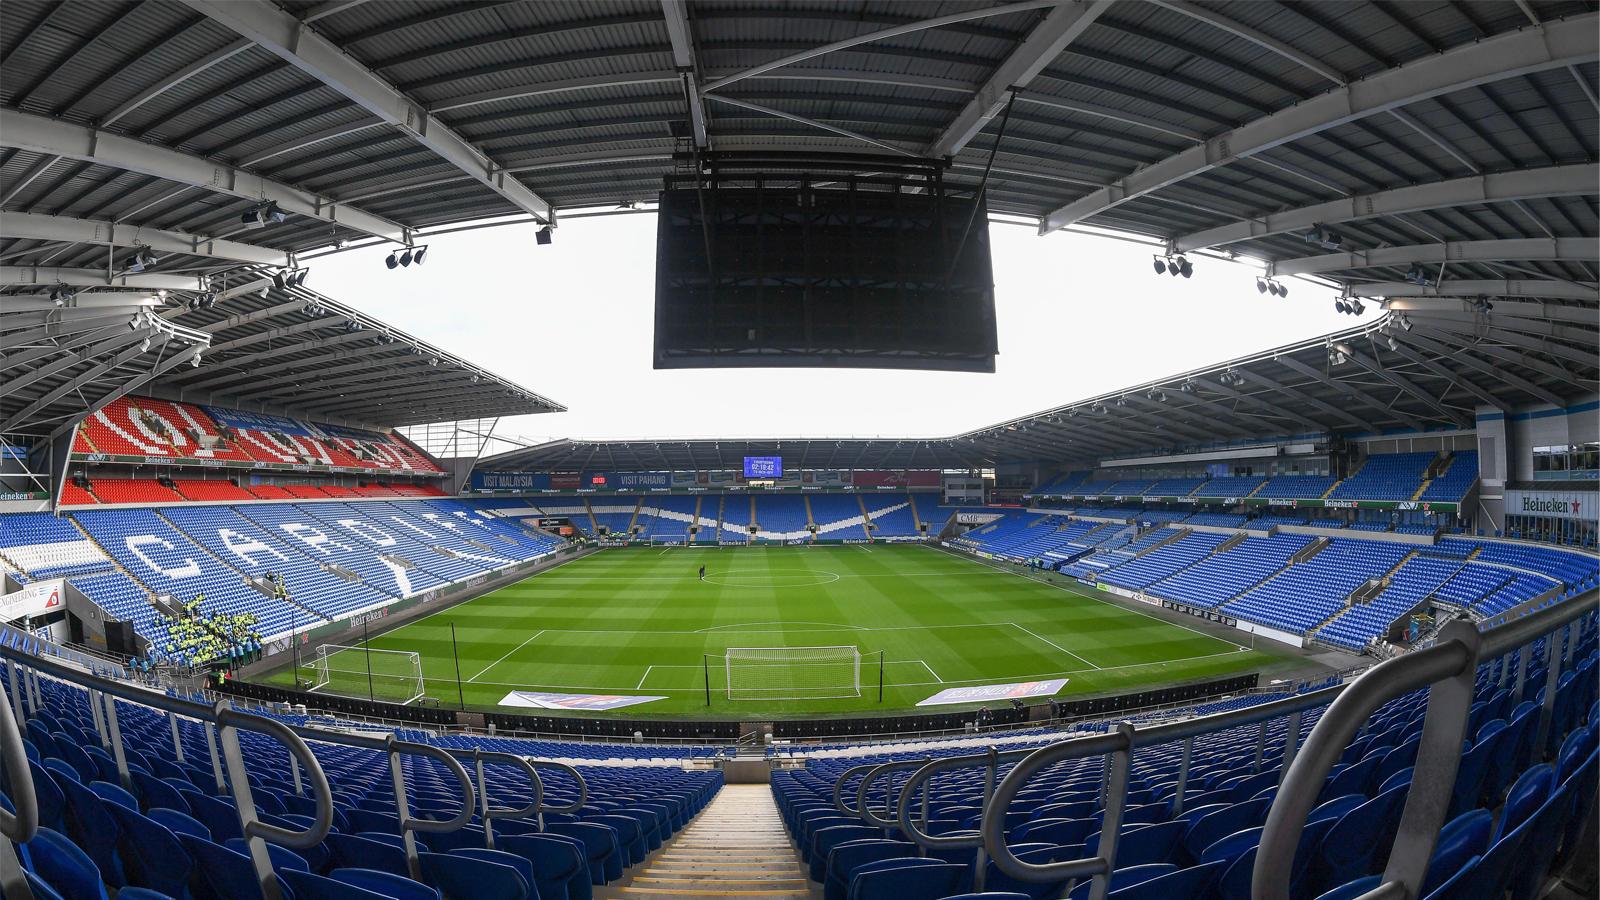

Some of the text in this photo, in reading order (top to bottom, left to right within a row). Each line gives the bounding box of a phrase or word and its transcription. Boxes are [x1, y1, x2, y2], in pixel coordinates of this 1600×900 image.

[483, 475, 533, 487] VISIT MALAYSIA
[621, 475, 666, 485] VISIT PAHANG
[0, 492, 28, 500] eineken
[1268, 498, 1292, 506] Heineken
[1324, 499, 1352, 507] Heineken
[1522, 497, 1568, 513] Heineken
[0, 588, 37, 607] NGINEERING
